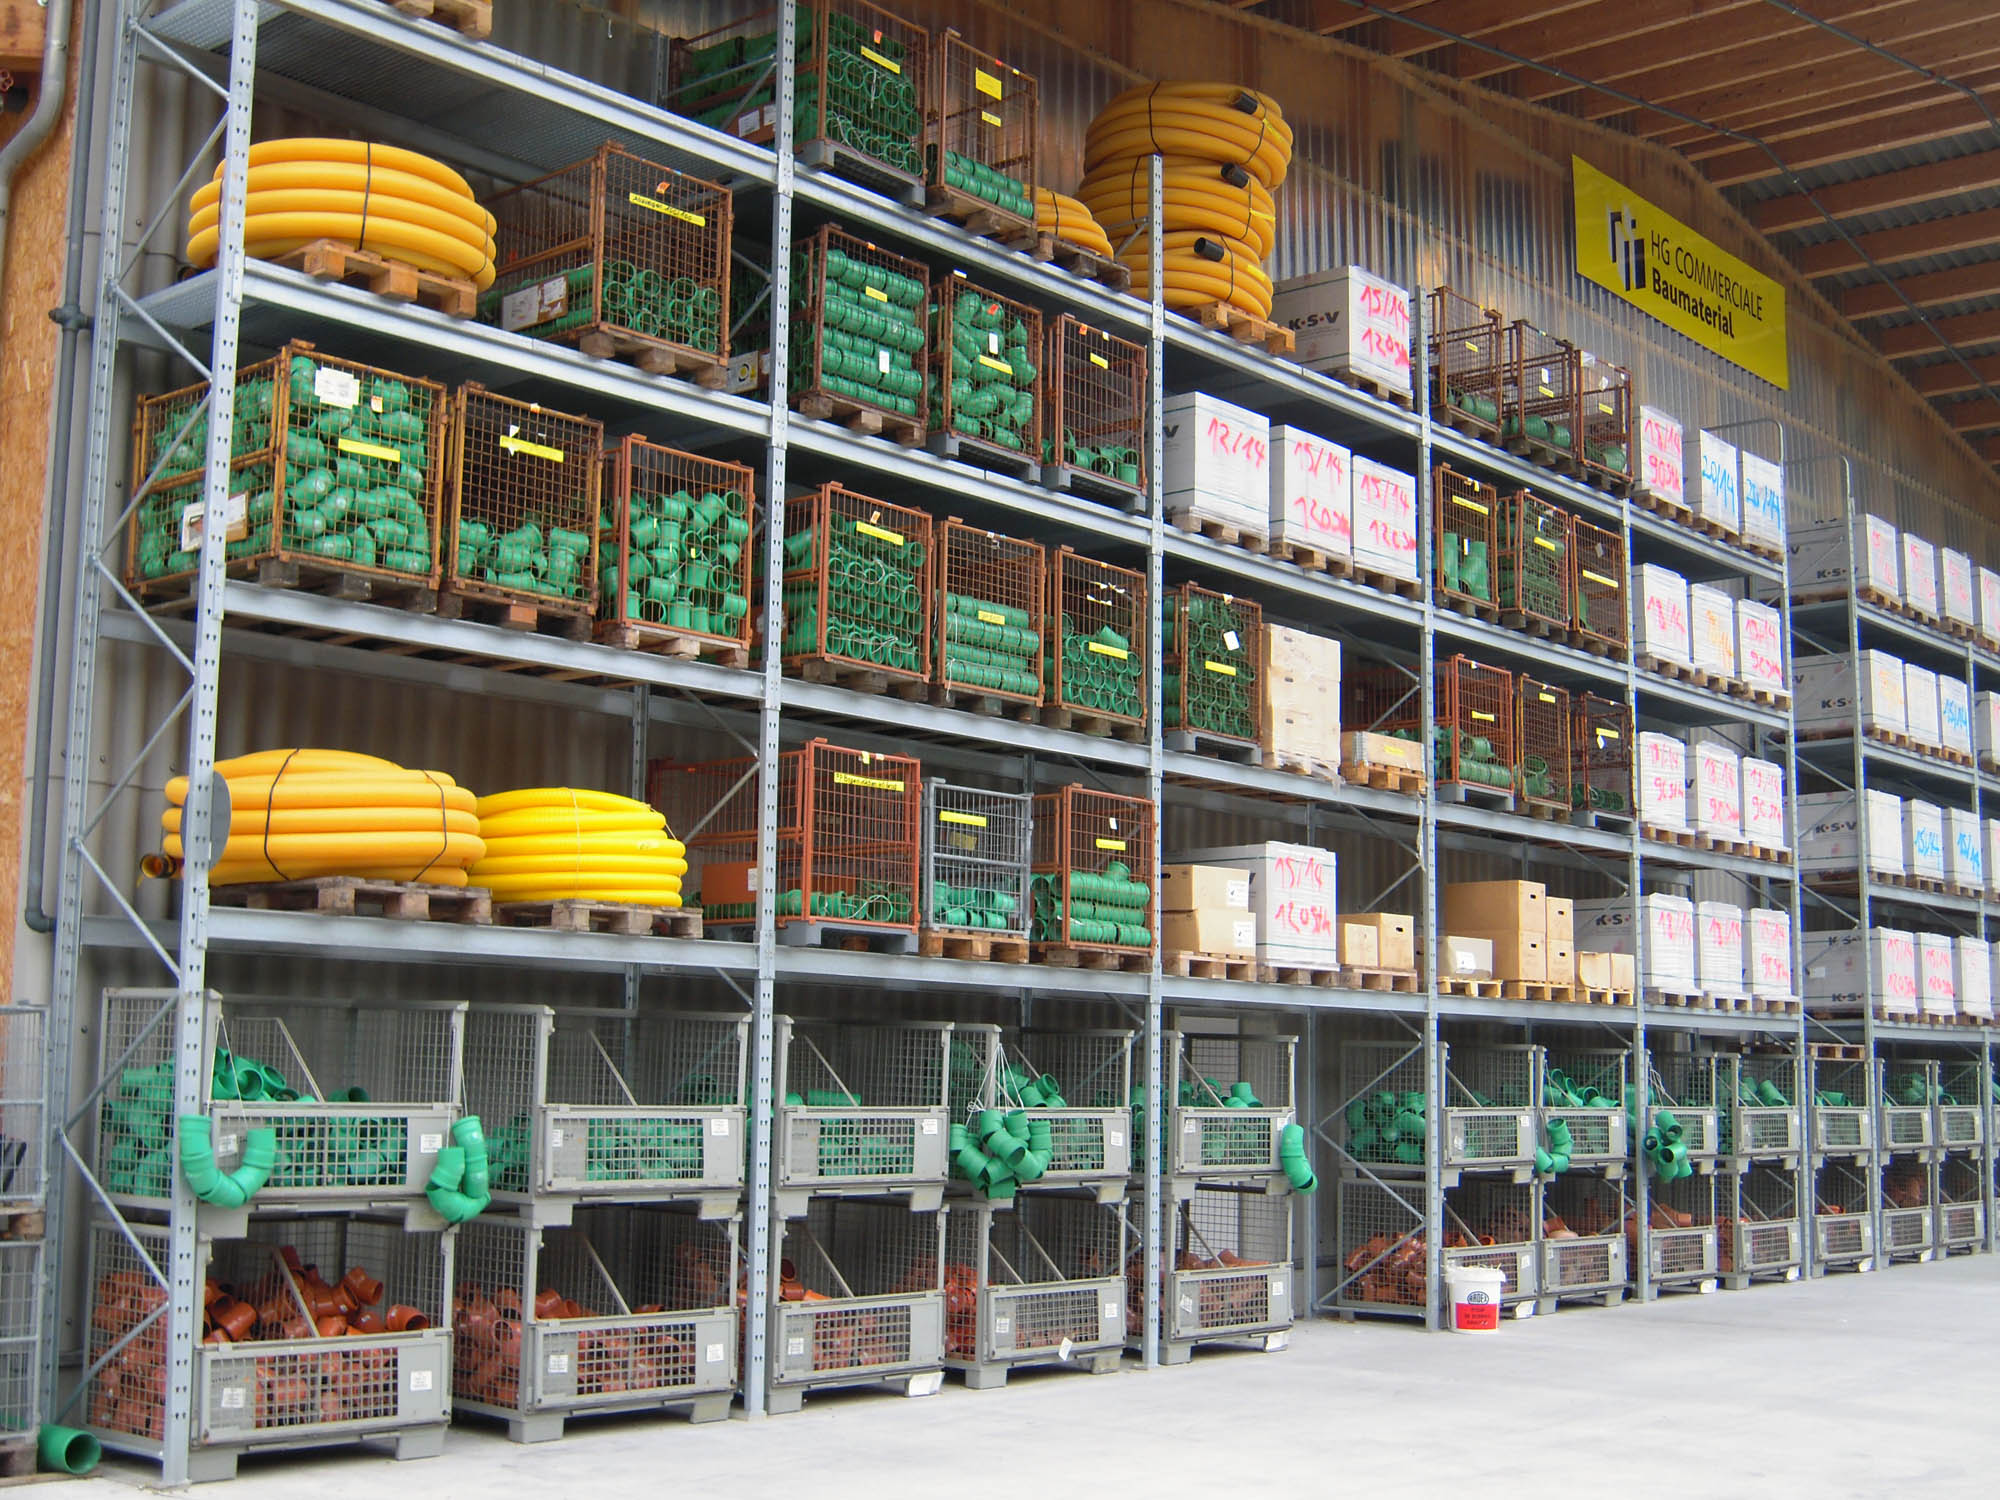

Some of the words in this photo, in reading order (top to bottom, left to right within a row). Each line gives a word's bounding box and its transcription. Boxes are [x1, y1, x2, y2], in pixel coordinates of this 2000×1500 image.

[1651, 230, 1670, 266] HG
[1675, 247, 1762, 321] COMMERCIALE
[1652, 267, 1735, 339] Baumaterial
[1208, 417, 1264, 469] 12/14
[1702, 455, 1736, 514] 20/14
[1275, 856, 1323, 892] 15/14
